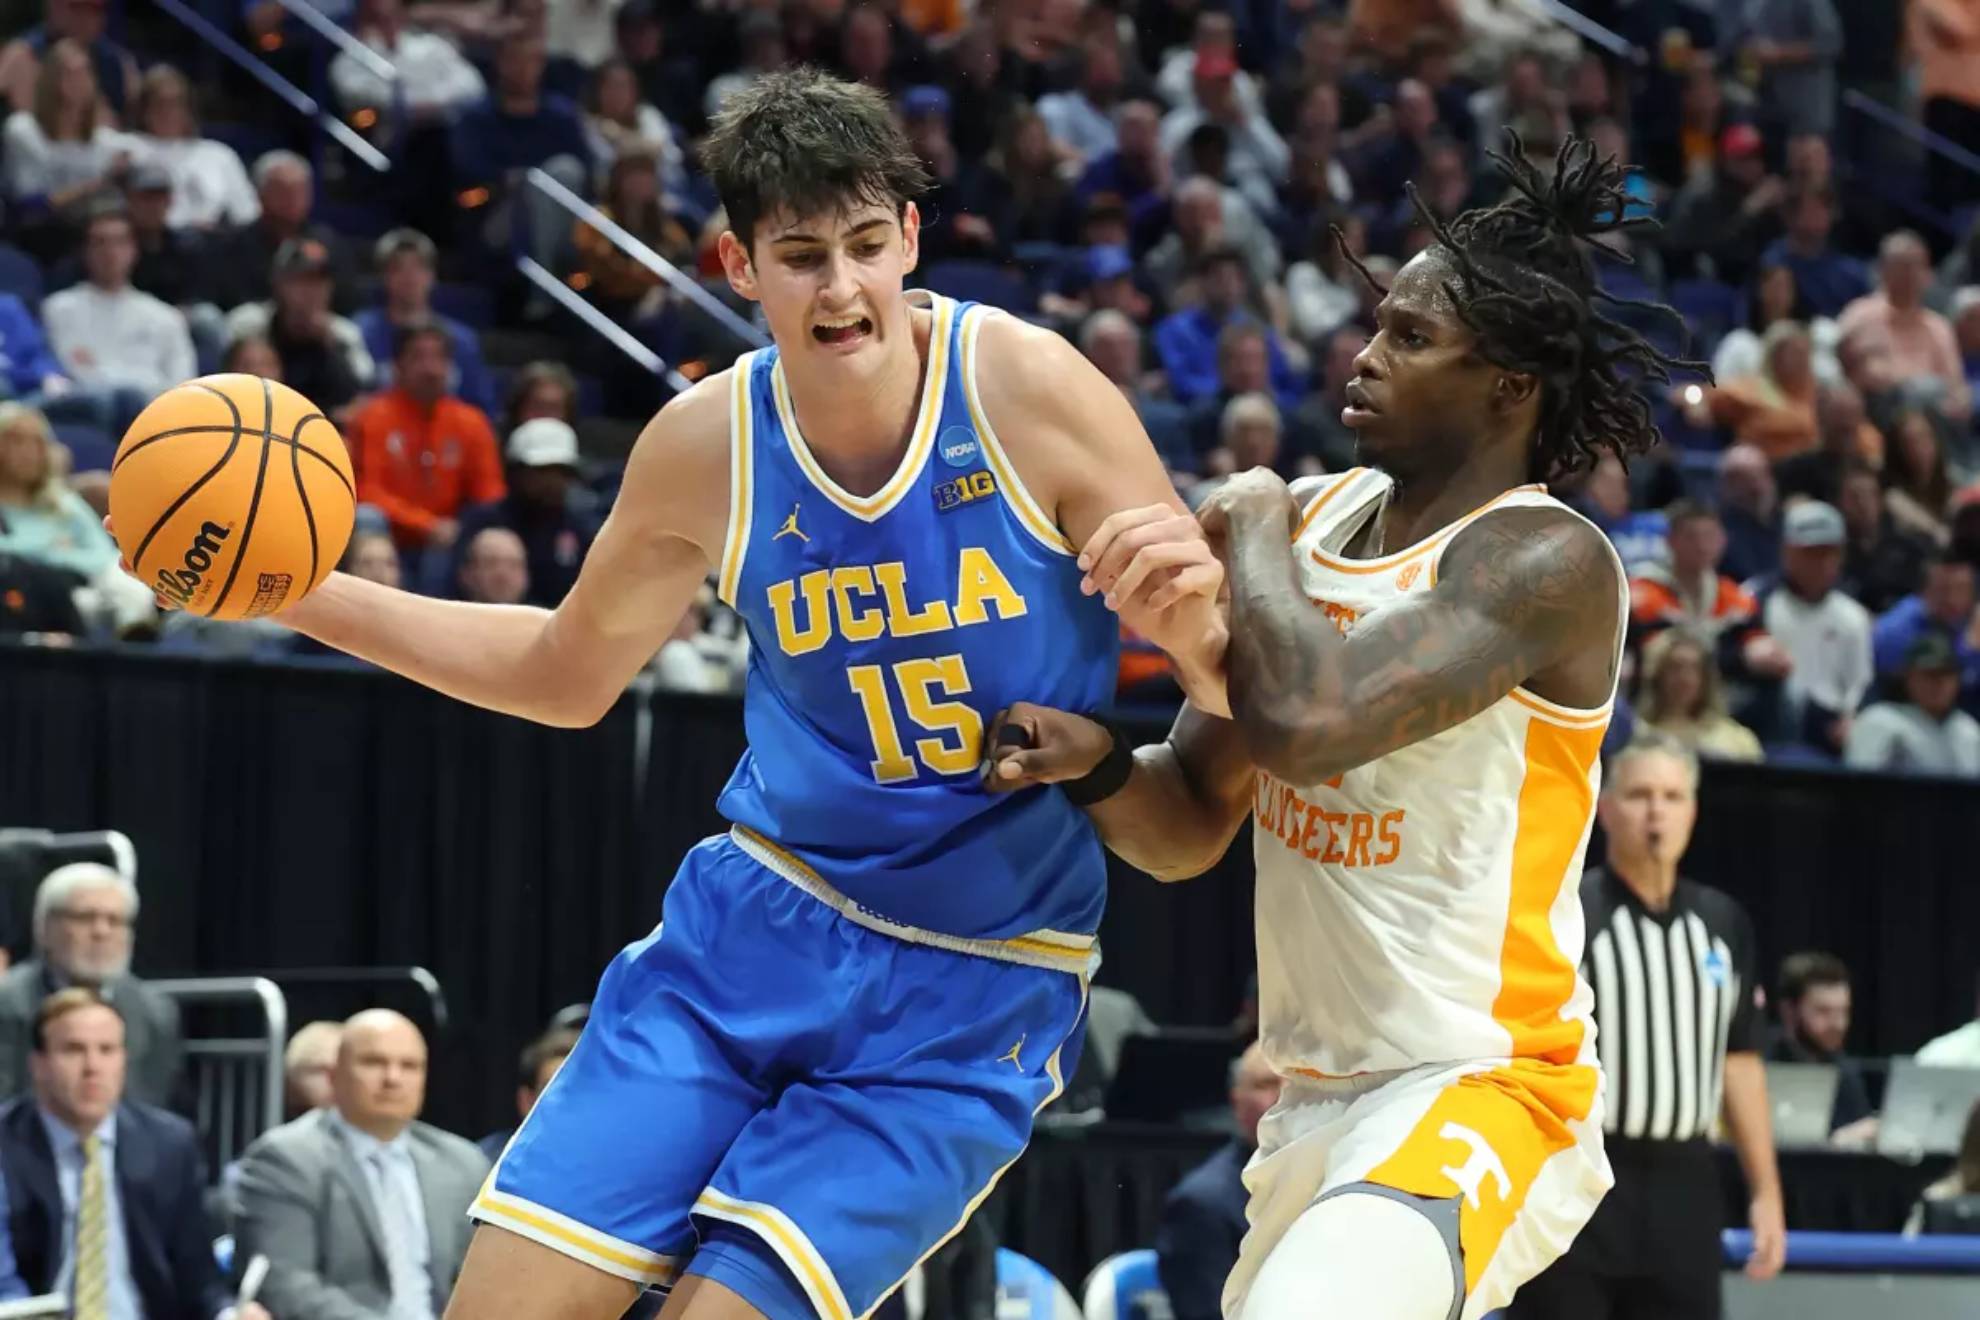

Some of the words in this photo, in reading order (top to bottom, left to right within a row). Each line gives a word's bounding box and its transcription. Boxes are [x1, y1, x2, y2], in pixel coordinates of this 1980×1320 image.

[152, 521, 231, 611] ilson
[766, 547, 1028, 657] UCLA
[846, 653, 984, 784] 15
